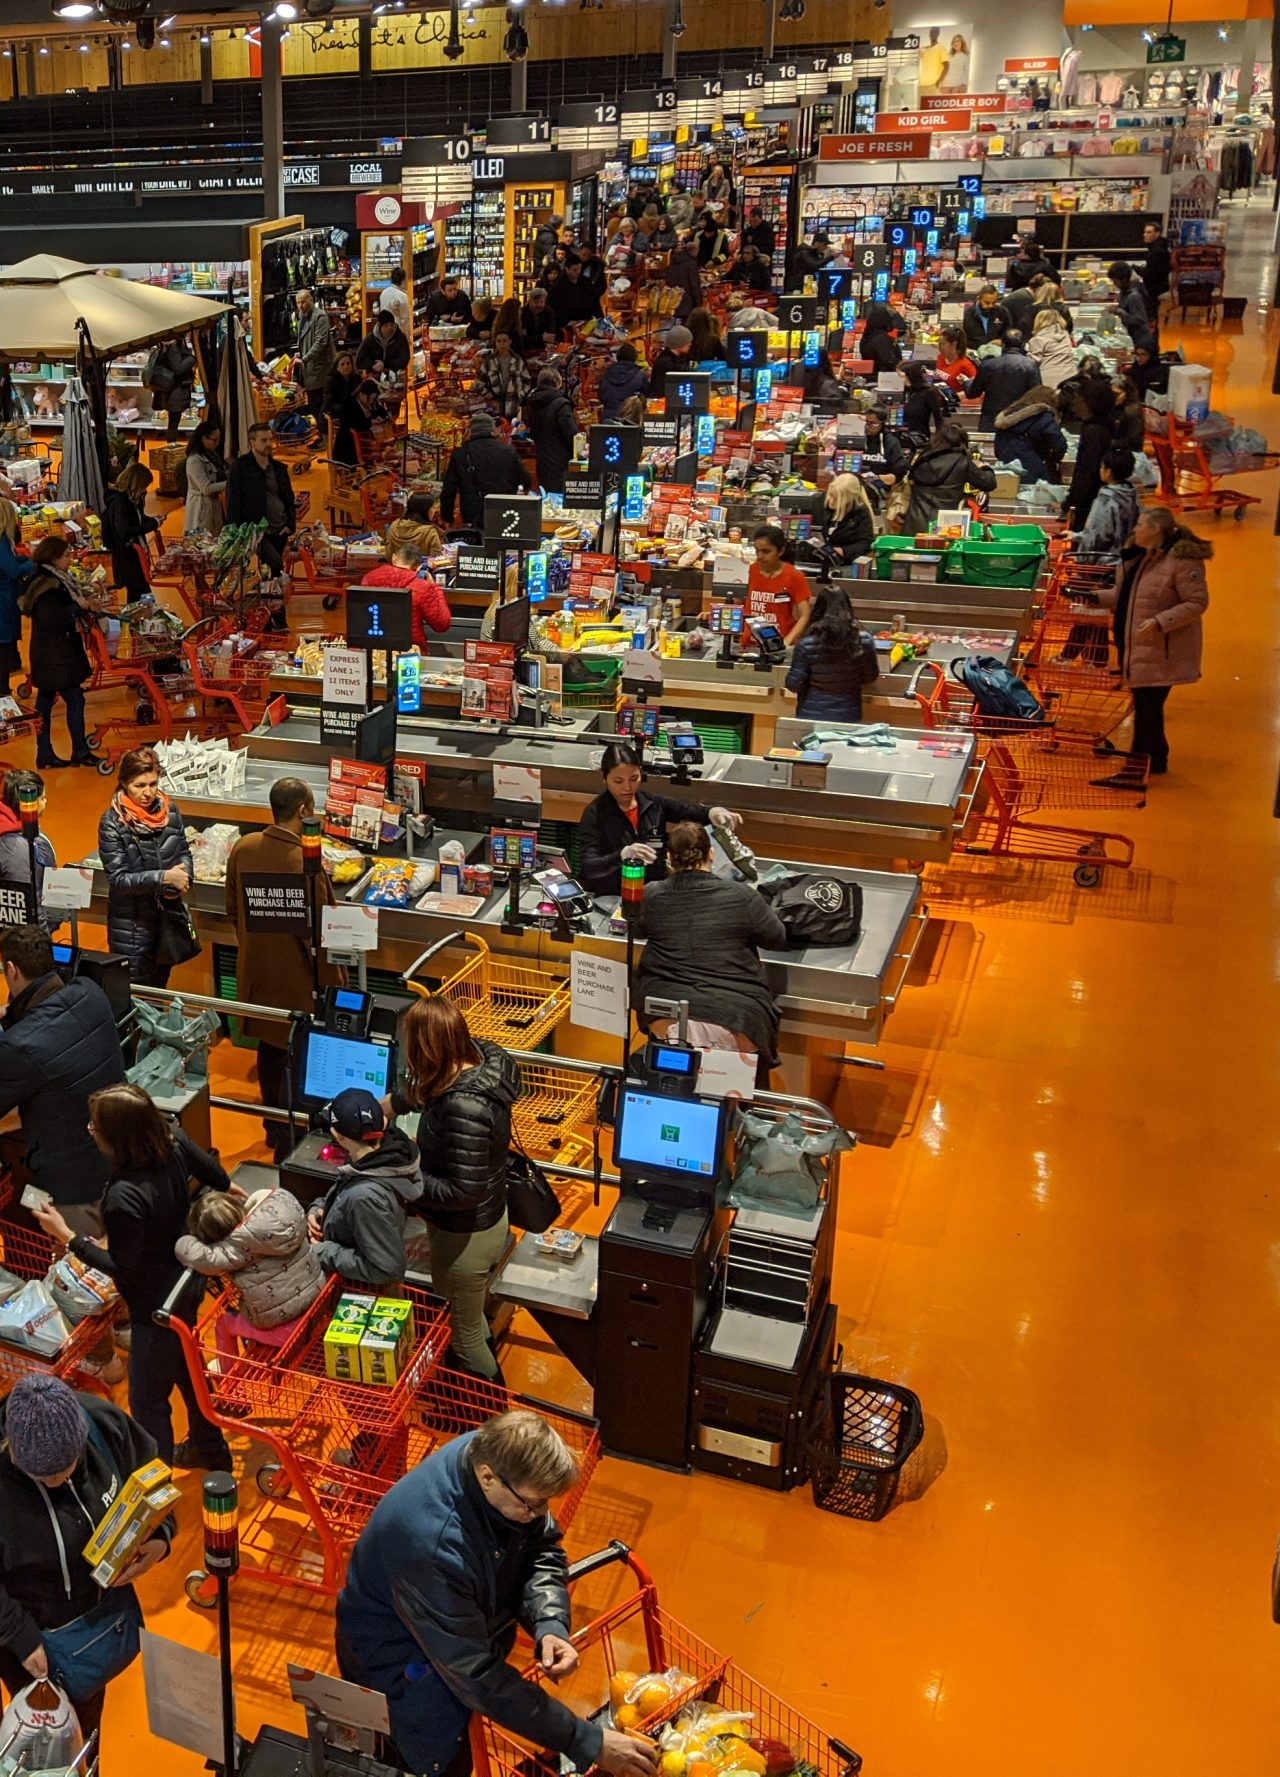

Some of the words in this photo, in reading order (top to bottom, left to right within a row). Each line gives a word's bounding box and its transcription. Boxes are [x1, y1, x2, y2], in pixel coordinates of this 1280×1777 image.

[904, 38, 918, 48] 20
[872, 46, 887, 57] 19
[812, 59, 827, 70] 17
[837, 53, 852, 64] 18
[1023, 60, 1048, 69] SLEEP
[778, 65, 796, 78] 16
[745, 73, 763, 86] 15
[703, 82, 720, 96] 14
[655, 92, 675, 107] 13
[927, 99, 975, 108] TODDLER
[977, 97, 1000, 107] BOY
[594, 106, 617, 122] 12
[898, 116, 918, 126] KID
[921, 114, 947, 125] GIRL
[528, 121, 549, 139] 11
[444, 140, 469, 160] 10
[838, 143, 864, 154] JOE
[869, 141, 913, 152] FRESH
[349, 163, 382, 173] LOCAL
[291, 167, 318, 184] CASE
[351, 173, 382, 183] BREWERIES
[961, 179, 979, 193] 12
[945, 194, 960, 207] 11
[913, 211, 931, 225] 10
[892, 228, 904, 244] 9
[862, 250, 875, 267] 8
[829, 275, 842, 294] 7
[789, 305, 803, 323] 6
[739, 339, 754, 360] 5
[678, 383, 693, 405] 4
[605, 436, 620, 462] 3
[502, 510, 519, 537] 2
[473, 557, 484, 565] AND
[459, 564, 483, 572] PURCHASE
[751, 591, 775, 603] DIVERT
[751, 601, 766, 612] FIVE
[368, 603, 384, 636] 1
[330, 655, 360, 664] EXPRESS
[329, 666, 347, 674] LANE
[338, 678, 360, 686] ITEMS
[334, 688, 354, 696] ONLY
[322, 710, 337, 719] WINE
[338, 711, 350, 719] AND
[323, 719, 350, 728] PURCHASE
[245, 887, 266, 898] WINE
[268, 888, 284, 898] AND
[286, 889, 304, 899] BEER
[249, 898, 285, 908] PURCHASE
[286, 899, 307, 909] LANE.
[577, 959, 596, 970] WINE
[597, 965, 612, 974] AND
[577, 968, 596, 979] BEER
[577, 978, 615, 993] PURCHASE
[577, 987, 595, 997] LANE
